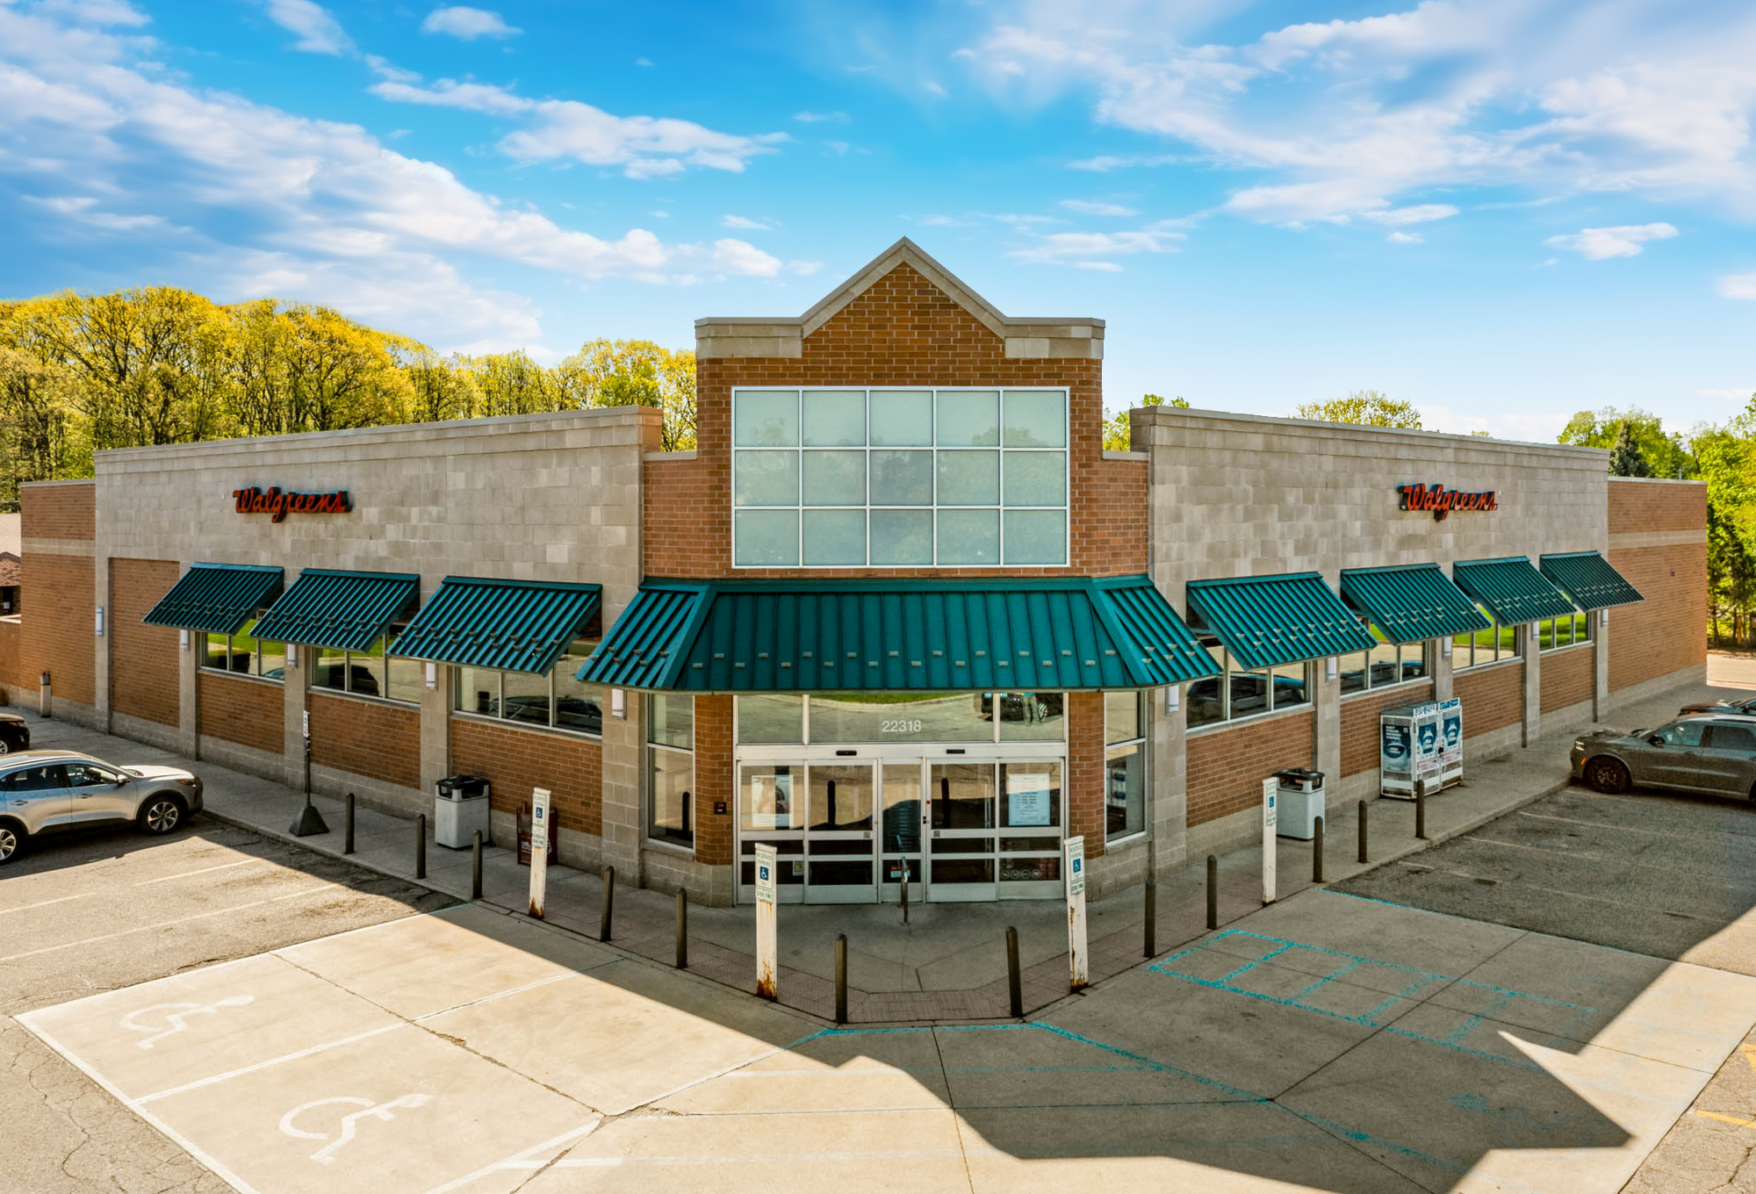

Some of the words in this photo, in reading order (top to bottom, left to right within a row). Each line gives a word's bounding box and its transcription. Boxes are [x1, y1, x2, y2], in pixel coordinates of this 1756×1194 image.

[233, 487, 350, 523] Walgreens
[1399, 483, 1498, 521] Walgreens
[881, 719, 922, 733] 22318
